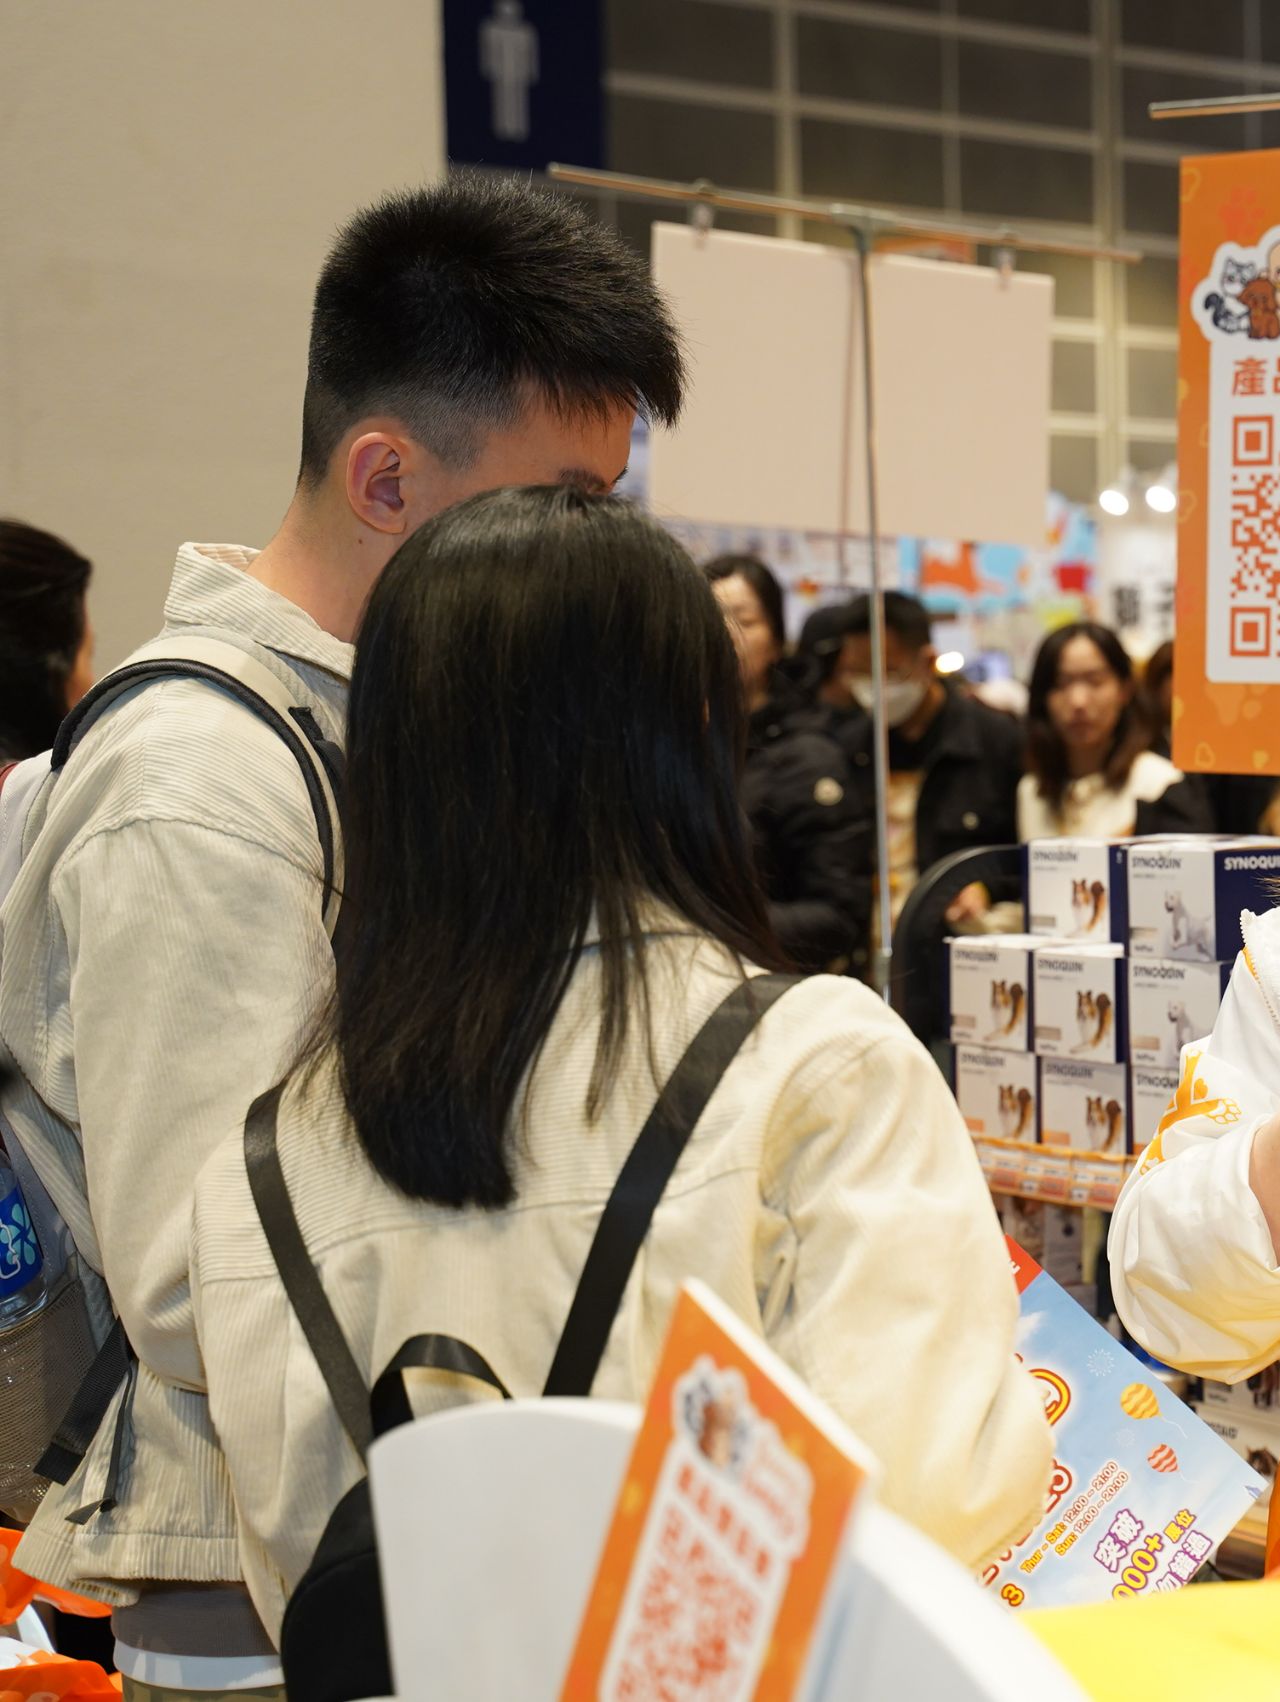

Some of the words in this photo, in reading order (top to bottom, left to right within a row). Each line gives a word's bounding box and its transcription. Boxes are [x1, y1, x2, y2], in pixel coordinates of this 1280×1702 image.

[1020, 1549, 1043, 1574] Thur
[1045, 1521, 1068, 1545] Sat:
[1063, 1495, 1088, 1524] 12:00
[1092, 1461, 1118, 1491] 21:00
[1055, 1531, 1079, 1557] Sun:
[1074, 1505, 1099, 1535] 12:00
[1102, 1471, 1129, 1502] 20:00
[1094, 1508, 1144, 1573] 突破
[1163, 1508, 1197, 1545] 展位
[1154, 1530, 1214, 1594] 勿錯過
